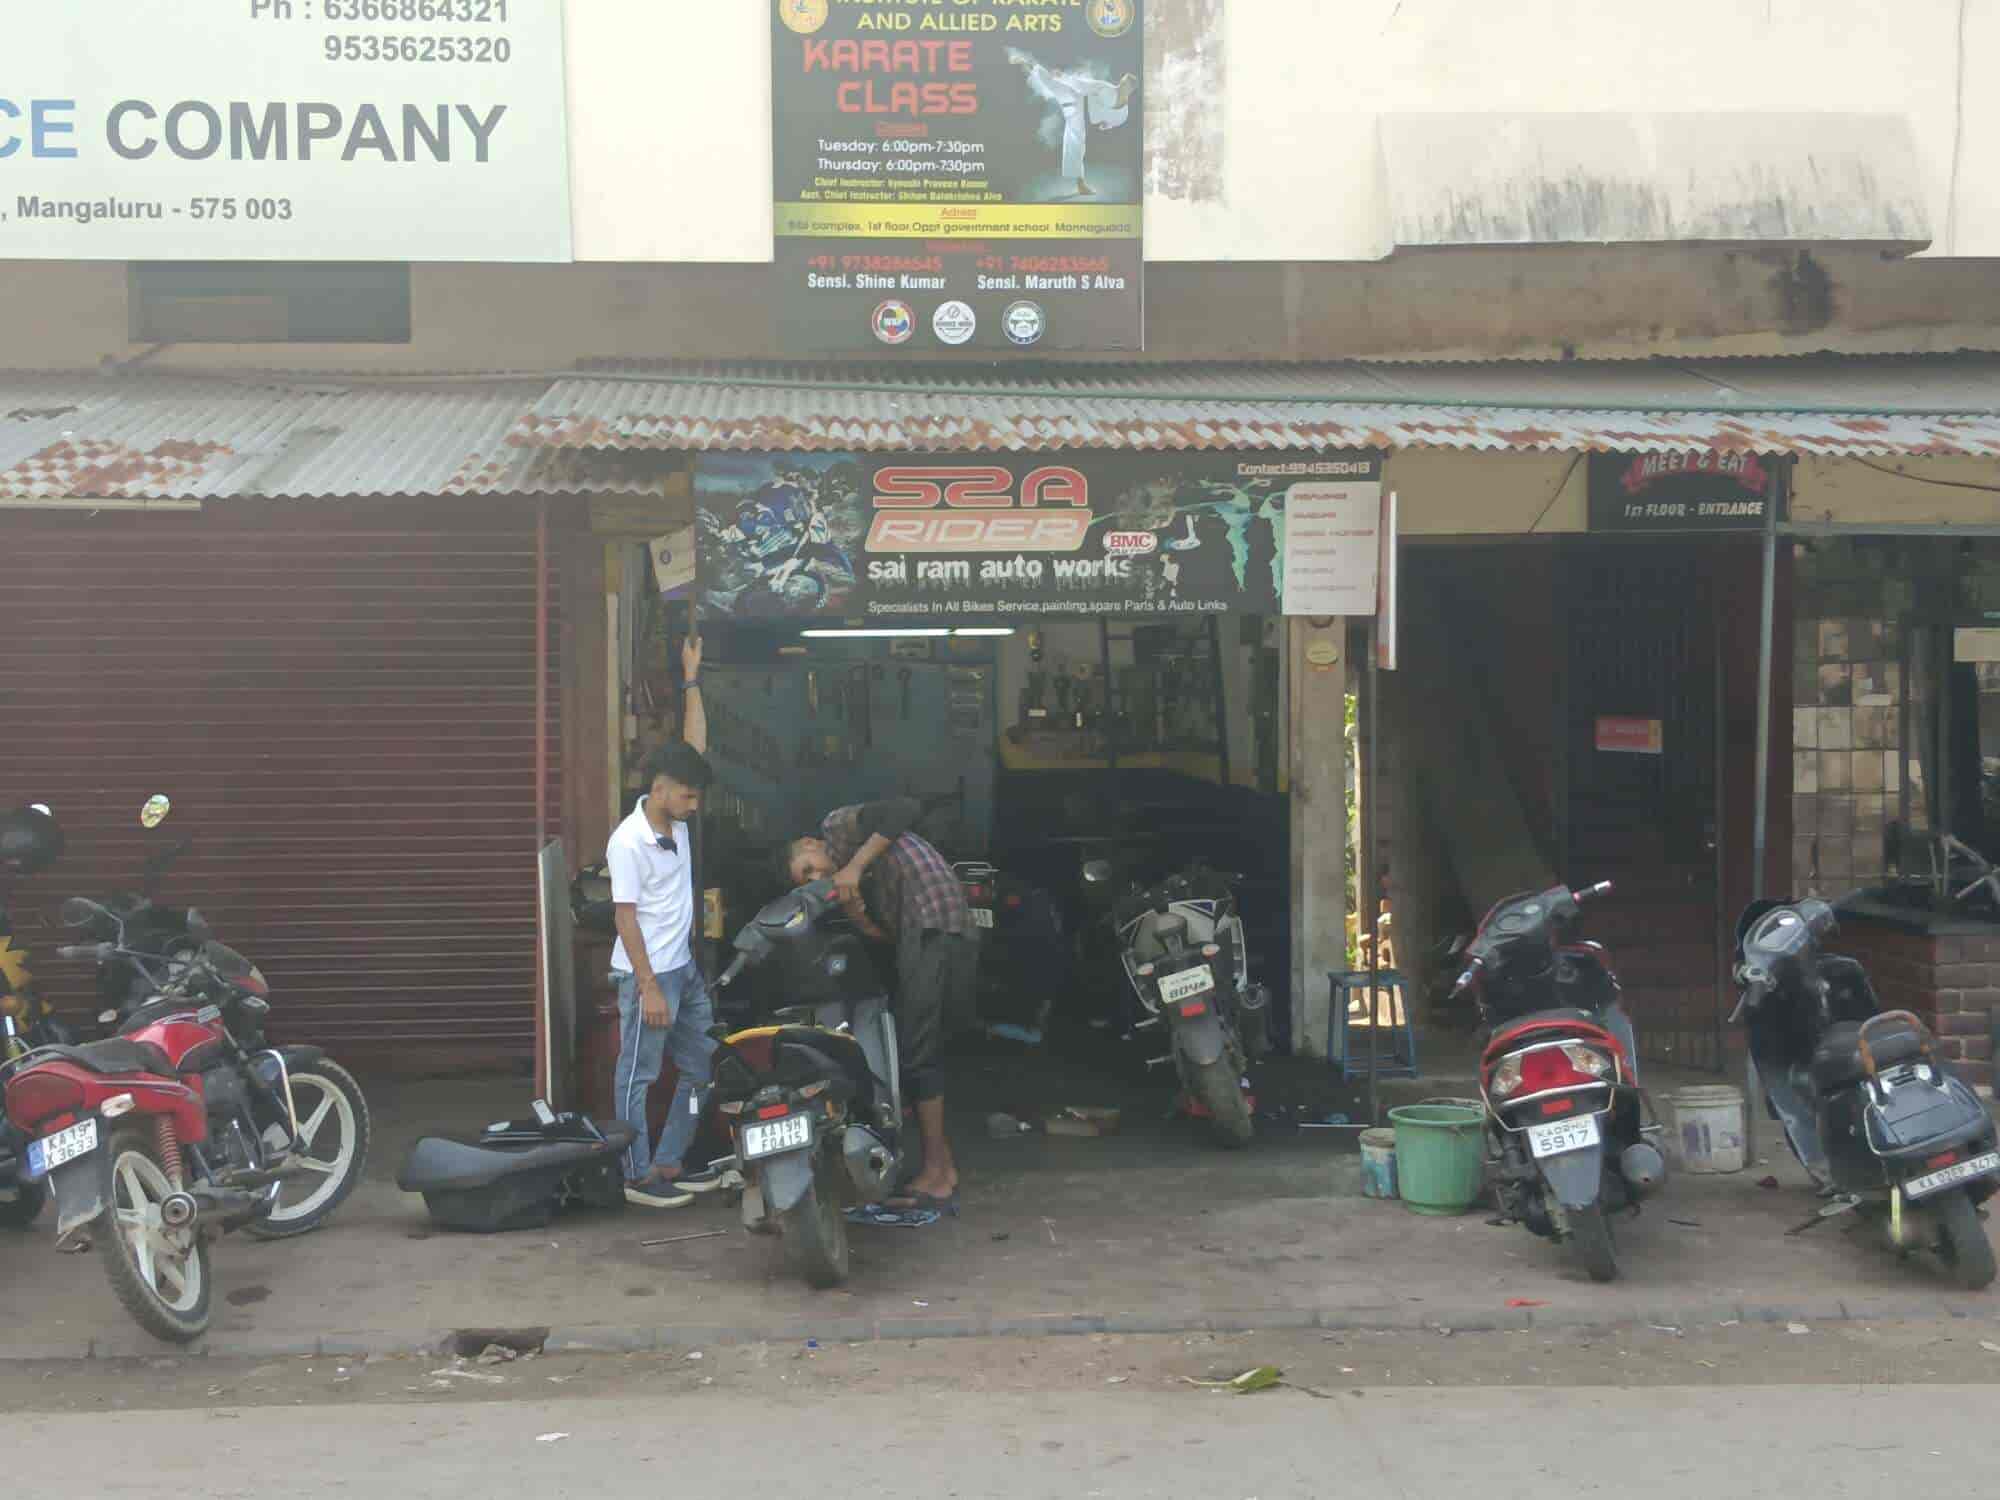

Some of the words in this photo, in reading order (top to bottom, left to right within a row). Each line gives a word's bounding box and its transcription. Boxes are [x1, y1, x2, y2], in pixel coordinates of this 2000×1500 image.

[251, 0, 292, 19] Ph
[323, 0, 508, 23] 6366864321
[857, 12, 912, 31] AND
[919, 13, 997, 31] ALLIED
[1005, 14, 1062, 32] ARTS
[324, 34, 511, 63] 9535625320
[803, 39, 974, 74] KARATE
[837, 80, 978, 114] CLASS
[105, 99, 507, 163] COMPANY
[817, 139, 879, 154] Tuesday:
[17, 196, 162, 224] Mangaluru
[191, 198, 237, 219] 575
[246, 198, 292, 219] 003
[856, 273, 896, 289] Shine
[901, 274, 946, 289] Kumar
[1025, 275, 1076, 289] Maruth
[1081, 275, 1089, 289] S
[1094, 276, 1125, 289] Alva
[1643, 455, 1688, 477] MEET
[1718, 456, 1748, 473] EAT
[872, 466, 1088, 508] S2A
[1646, 504, 1685, 517] FLOOR
[1699, 502, 1763, 516] ENTRANCE
[875, 519, 1081, 543] RIDER
[1110, 535, 1151, 547] BMC
[867, 555, 906, 579] sai
[917, 559, 970, 579] ram
[980, 555, 1043, 579] auto
[1053, 554, 1132, 578] works
[945, 601, 960, 612] All
[1156, 601, 1166, 611] &
[1168, 601, 1194, 611] Auto
[1197, 601, 1228, 612] Links
[1540, 1129, 1588, 1151] 5917
